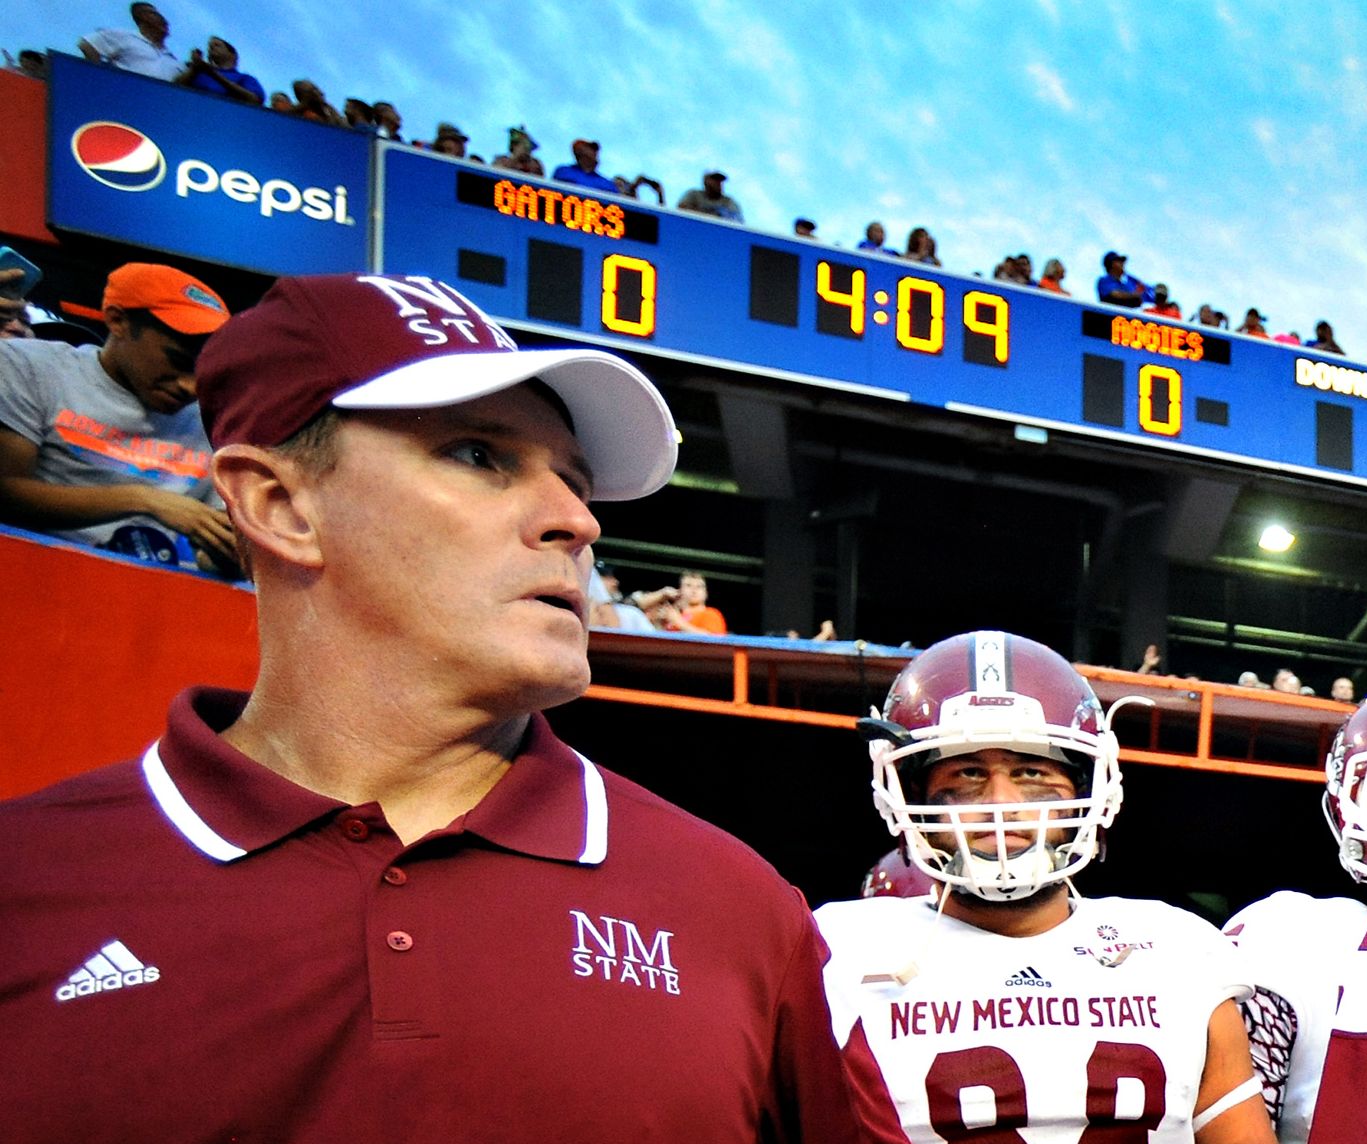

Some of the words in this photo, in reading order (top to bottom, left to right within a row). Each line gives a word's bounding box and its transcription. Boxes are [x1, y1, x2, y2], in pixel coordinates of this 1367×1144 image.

[176, 158, 348, 224] pepsi
[493, 179, 625, 240] GATORS
[601, 253, 656, 337] 0
[816, 261, 1009, 363] 4:09
[1111, 315, 1204, 361] AGGIES
[1138, 363, 1182, 436] 0
[570, 909, 678, 973] NM
[55, 962, 161, 1001] adidas
[573, 953, 681, 995] STATE
[1004, 977, 1053, 988] adidas
[890, 1001, 962, 1040] NEW
[972, 995, 1080, 1032] MEXICO
[1087, 995, 1161, 1029] STATE
